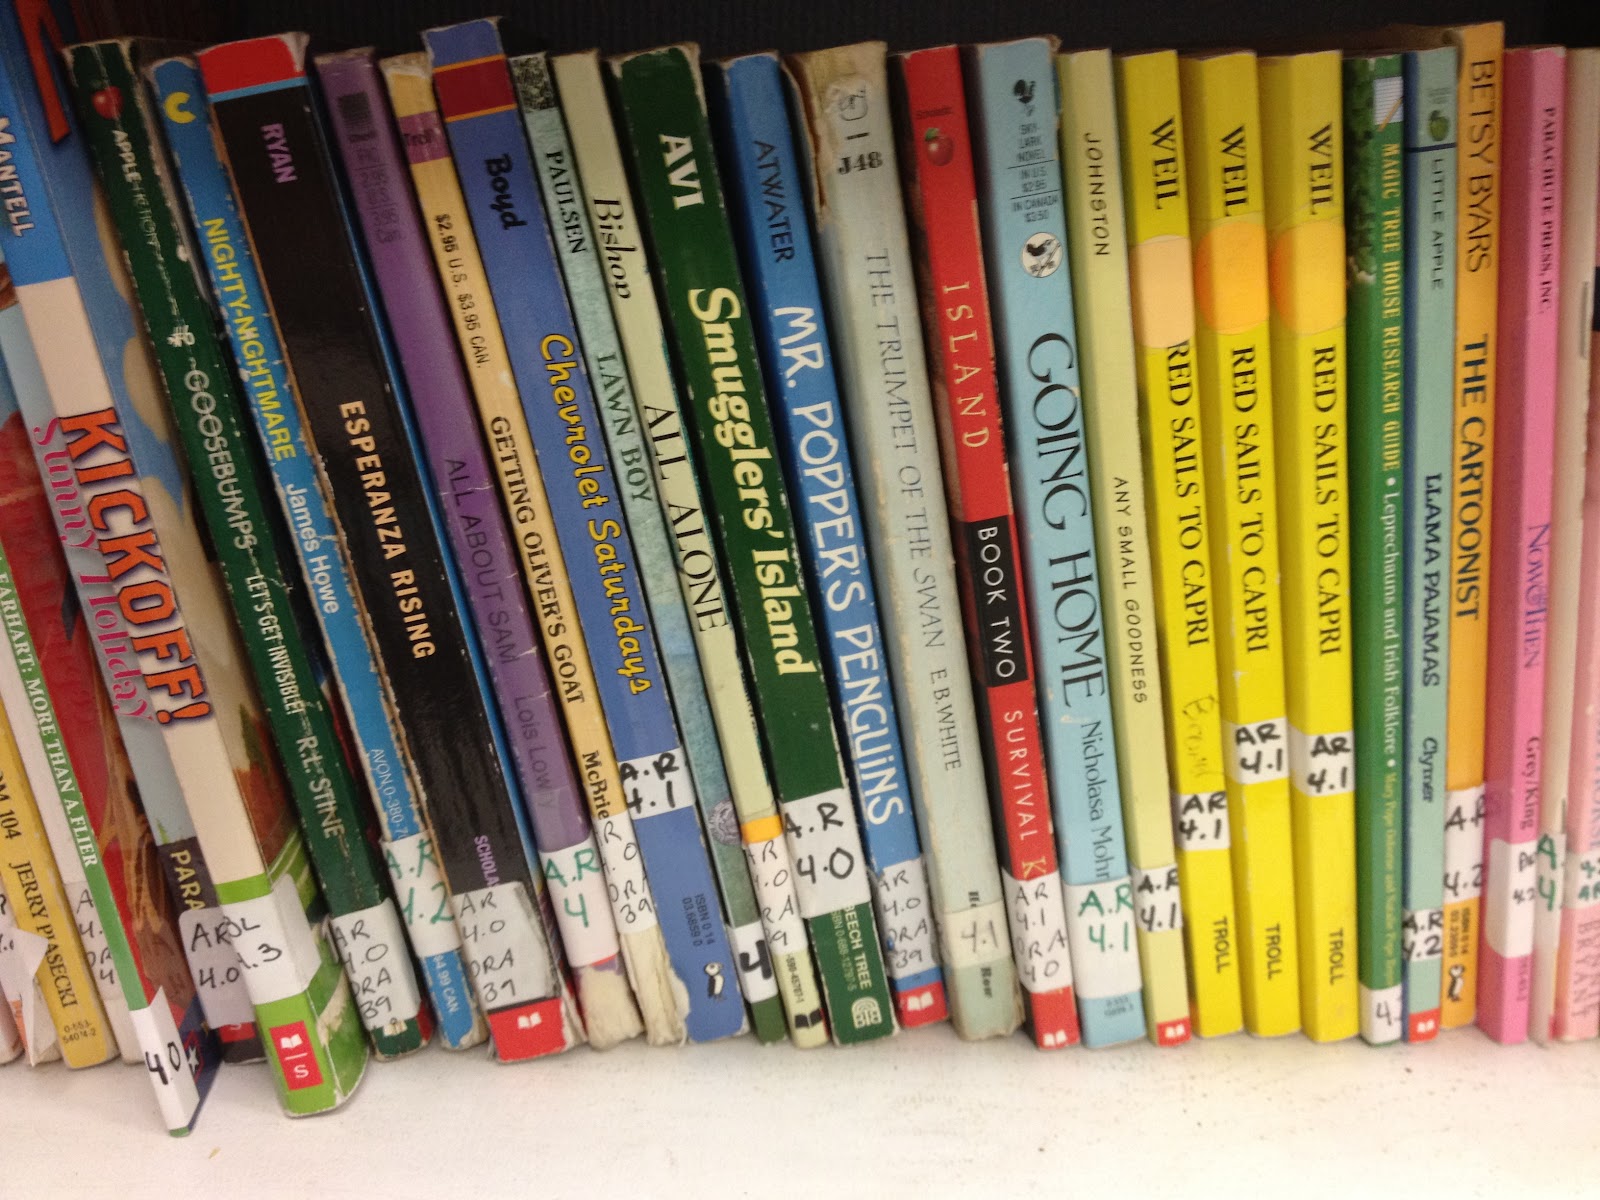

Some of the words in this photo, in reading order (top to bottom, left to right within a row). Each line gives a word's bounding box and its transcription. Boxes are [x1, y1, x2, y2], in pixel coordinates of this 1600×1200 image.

[1467, 59, 1497, 165] BETSY
[111, 128, 142, 185] APPLE
[260, 122, 298, 184] RYAN
[658, 133, 705, 211] AVI
[1150, 117, 1181, 211] WEIL
[1220, 124, 1250, 218] WEIL
[1308, 122, 1336, 216] WEIL
[1380, 143, 1400, 201] MAGIC
[1541, 107, 1556, 209] PARACHUTE
[483, 152, 528, 233] Boyd
[546, 150, 588, 255] PAULSEN
[752, 139, 796, 264] ATWATER
[1085, 132, 1111, 257] JOHNSTON
[1431, 158, 1446, 224] LITTLE
[1464, 173, 1496, 274] BYARS
[593, 196, 638, 301] Bishop
[1381, 206, 1401, 254] TREE
[1430, 229, 1445, 291] APPLE
[1540, 218, 1555, 279] PRESS,
[865, 247, 897, 309] THE
[1382, 259, 1401, 319] HOUSE
[202, 217, 297, 462] NIGHTY-NIGHTMARE
[773, 305, 826, 390] MR.
[942, 280, 991, 450] ISLAND
[1166, 339, 1195, 408] RED
[1382, 327, 1401, 414] RESEARCH
[1460, 332, 1489, 408] THE
[876, 314, 918, 455] TRUMPET
[1232, 345, 1259, 414] RED
[1313, 343, 1338, 414] RED
[184, 369, 257, 551] GOOSEBUMPS
[596, 353, 634, 438] LAWN
[620, 448, 654, 503] BOY
[1027, 331, 1089, 532] GOING
[1171, 415, 1201, 499] SAILS
[1381, 420, 1401, 471] GUIDE
[33, 417, 99, 552] Sunny
[687, 286, 786, 540] Smugglers'
[751, 548, 817, 676] Island
[898, 465, 924, 500] OF
[1113, 476, 1132, 517] ANY
[1234, 423, 1262, 506] SAILS
[1314, 422, 1339, 506] SAILS
[338, 399, 406, 561] ESPERANZA
[390, 568, 437, 660] RISING
[539, 332, 612, 511] Chevrolet
[588, 518, 653, 697] Saturdays
[643, 403, 688, 482] ALL
[666, 501, 730, 633] ALONE
[791, 400, 868, 614] POPPER'S
[904, 506, 933, 561] THE
[1177, 505, 1205, 551] TO
[1240, 510, 1265, 558] TO
[1316, 510, 1341, 559] TO
[1423, 472, 1443, 566] LLAMA
[1455, 416, 1487, 622] CARTOONIST
[57, 406, 211, 726] KICKOFF!
[285, 482, 321, 553] James
[308, 554, 340, 615] Howe
[445, 458, 467, 507] ALL
[459, 513, 502, 601] ABOUT
[487, 608, 518, 665] SAM
[490, 415, 537, 525] GETTING
[524, 530, 568, 639] OLIVER'S
[552, 643, 586, 705] GOAT
[976, 525, 1007, 606] BOOK
[1119, 526, 1139, 590] SMALL
[1379, 492, 1400, 606] Leprechauns
[244, 574, 272, 615] LET'S
[912, 566, 947, 650] SWAN
[1048, 549, 1107, 708] HOME
[1181, 559, 1211, 649] CAPRI
[1241, 566, 1270, 654] CAPRI
[1317, 566, 1342, 658] CAPRI
[1383, 608, 1400, 641] and
[1422, 570, 1441, 688] PAJAMAS
[257, 616, 282, 645] GET
[989, 615, 1016, 680] TWO
[1125, 598, 1148, 704] GOODNESS
[1383, 643, 1400, 683] Irish
[266, 647, 304, 717] INVISIBLE!
[1235, 722, 1282, 747] AR
[1310, 735, 1351, 758] AR
[1383, 685, 1401, 756] Folklore
[24, 679, 55, 736] MORE
[45, 739, 75, 794] THAN
[69, 812, 99, 869] FLIER
[618, 751, 681, 784] A.R
[1003, 709, 1036, 842] SURVIVAL
[1080, 719, 1108, 823] Nicholasa
[1239, 747, 1284, 776] 4.1
[1306, 767, 1348, 795] 4.1
[0, 810, 23, 841] 104
[307, 778, 346, 839] STINE
[782, 801, 844, 839] A.R
[1178, 818, 1223, 841] 4.1
[1181, 790, 1227, 816] AR
[543, 847, 602, 890] A.R
[796, 846, 856, 885] 4.0
[1090, 824, 1114, 880] Mohr
[8, 860, 49, 921] JERRY
[36, 922, 79, 1009] PIASECKI
[333, 918, 371, 949] AR
[457, 892, 499, 919] AR
[461, 919, 507, 943] 4.0
[563, 893, 590, 928] 4
[1015, 907, 1046, 931] 4.1
[1077, 882, 1134, 918] A.R
[1139, 901, 1177, 933] 4.1
[1401, 910, 1443, 935] A.R
[738, 939, 774, 981] 4
[854, 952, 873, 989] TREE
[1088, 920, 1130, 953] 4.1
[1212, 916, 1231, 975] TROLL
[1264, 923, 1283, 981] TROLL
[1328, 927, 1346, 986] TROLL
[293, 1064, 310, 1080] S
